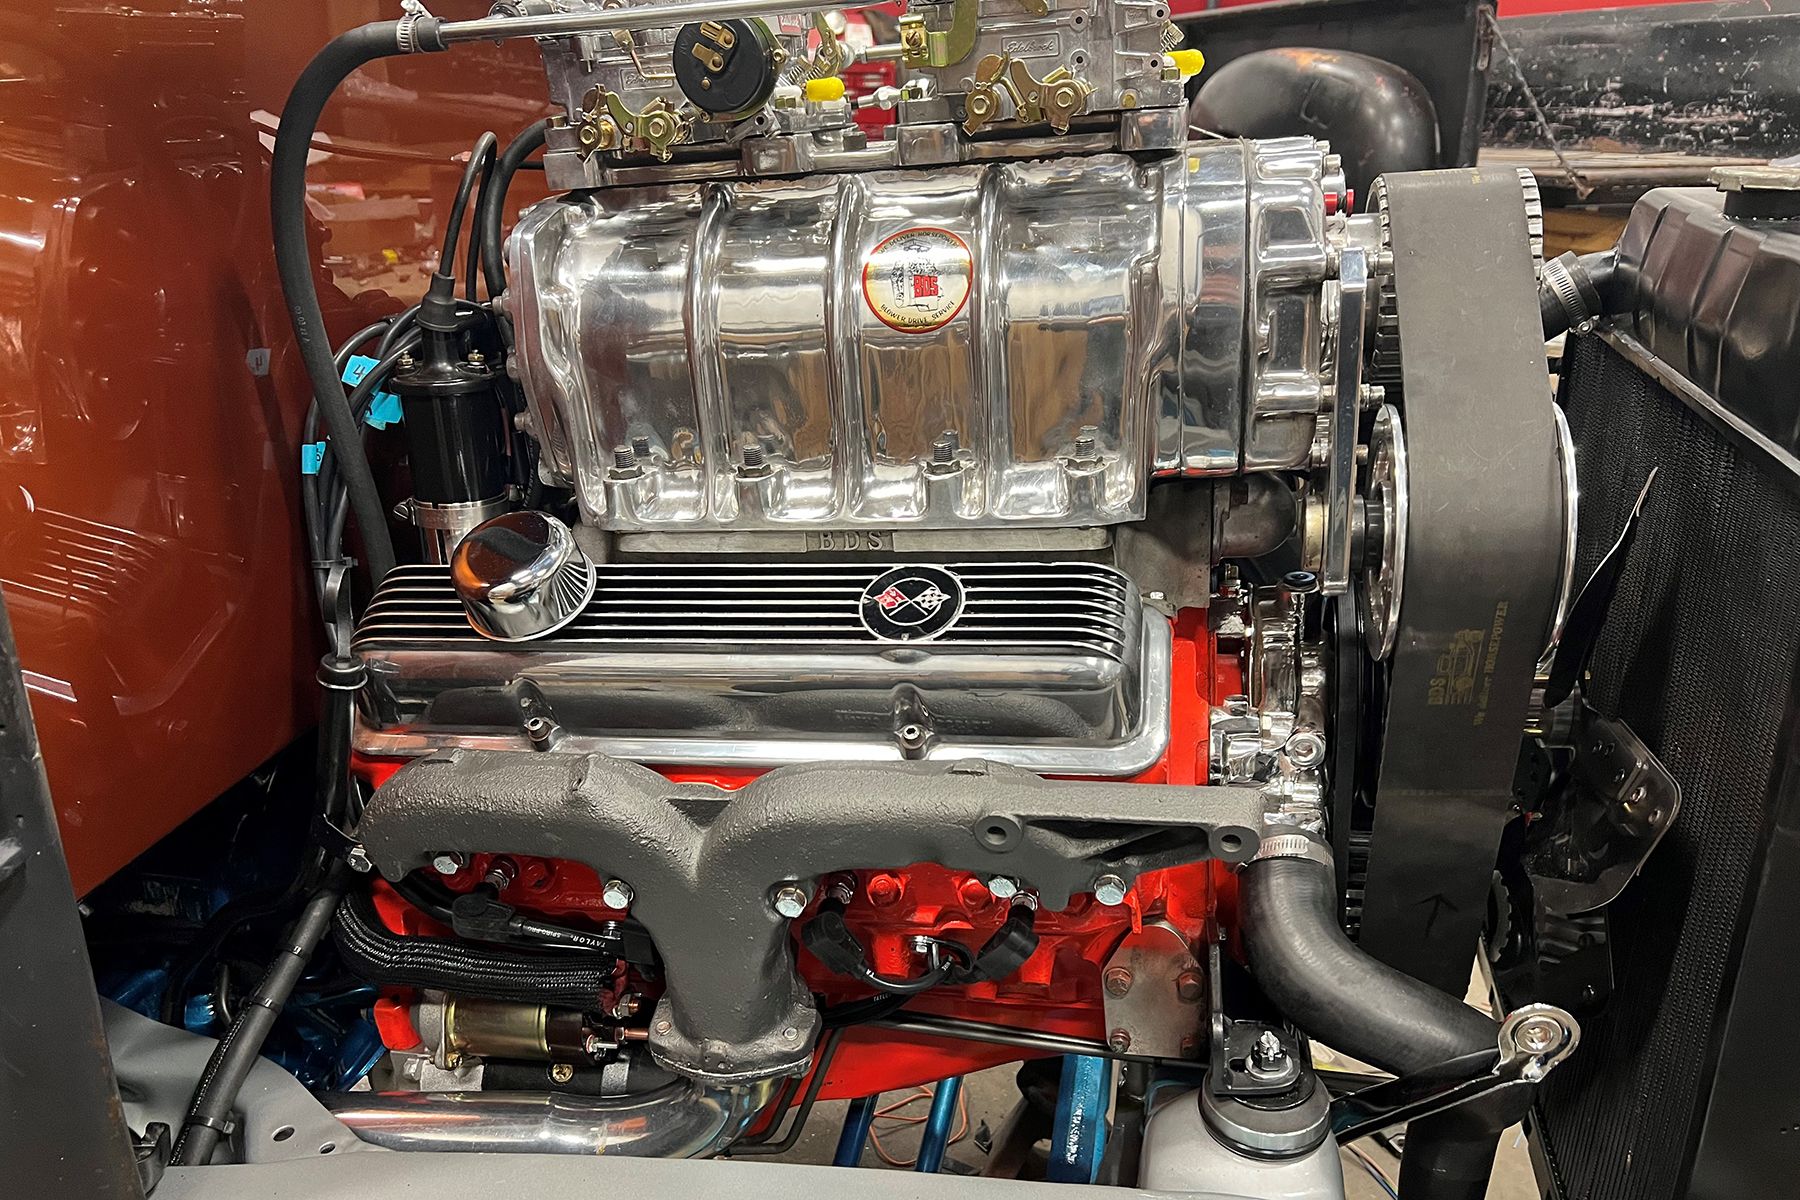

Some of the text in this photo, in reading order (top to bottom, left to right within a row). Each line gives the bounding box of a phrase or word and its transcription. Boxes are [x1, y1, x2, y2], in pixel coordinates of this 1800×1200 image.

[913, 274, 939, 298] BDS
[880, 300, 956, 325] BLOWER DRIVE SERVICE
[352, 364, 367, 381] 4
[819, 530, 883, 551] BDS
[1428, 678, 1446, 704] BDS
[572, 935, 607, 948] TAYLOR
